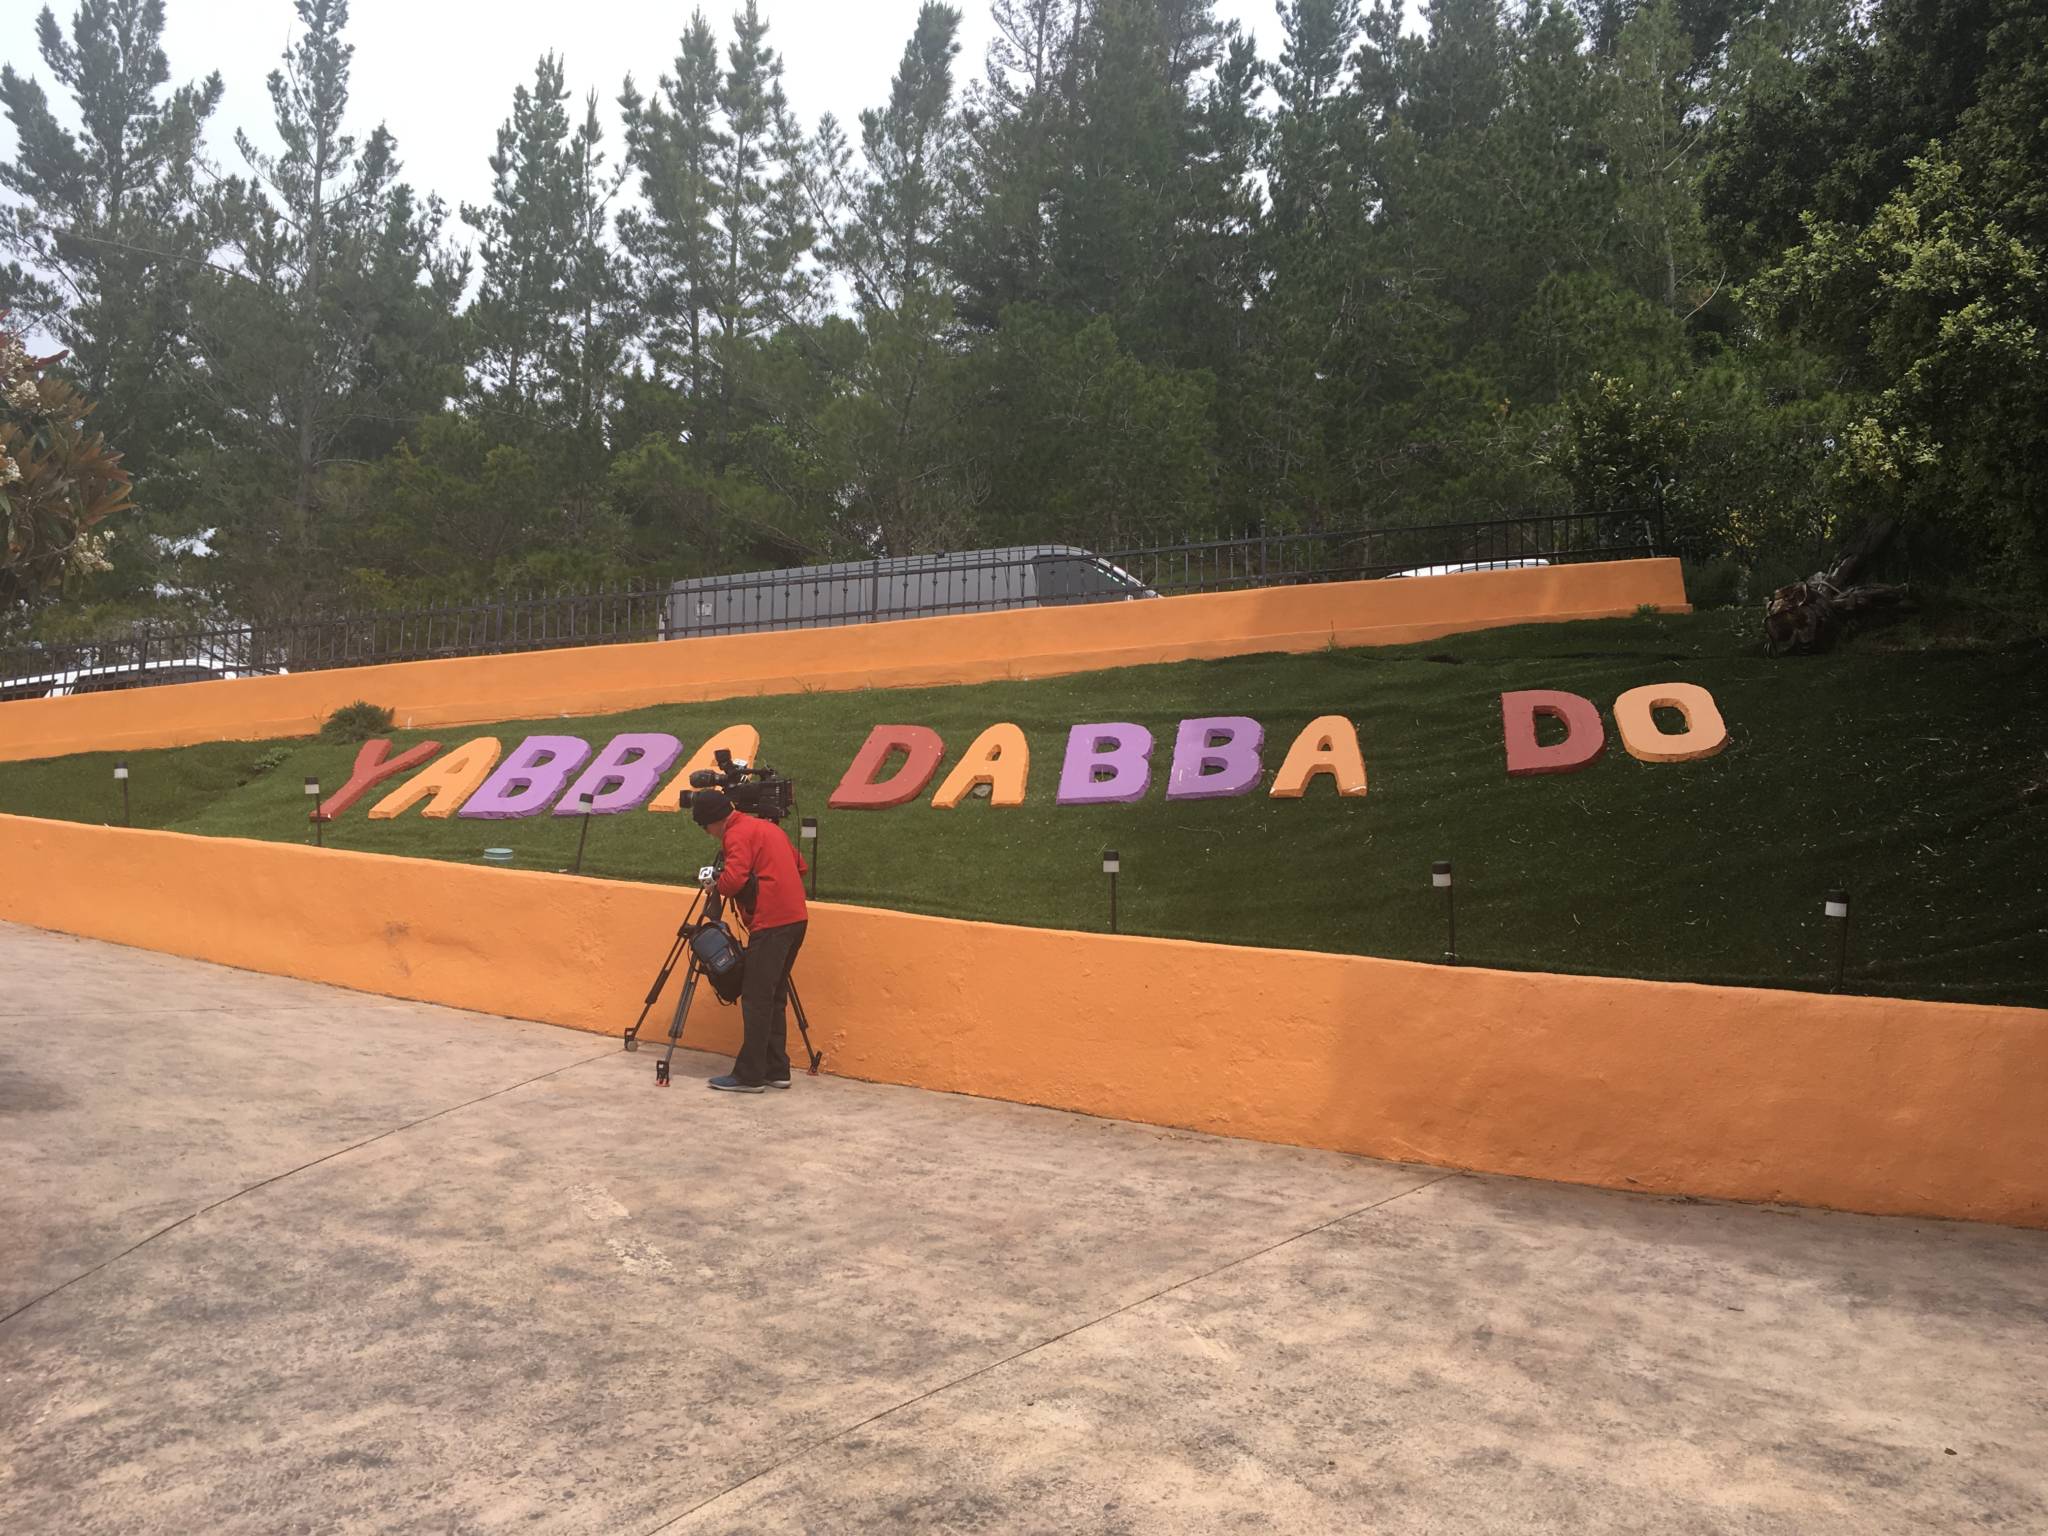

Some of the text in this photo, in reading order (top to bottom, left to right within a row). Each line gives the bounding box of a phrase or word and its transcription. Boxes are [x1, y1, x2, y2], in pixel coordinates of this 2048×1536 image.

[310, 682, 1728, 820] YABBA DABBA DO
